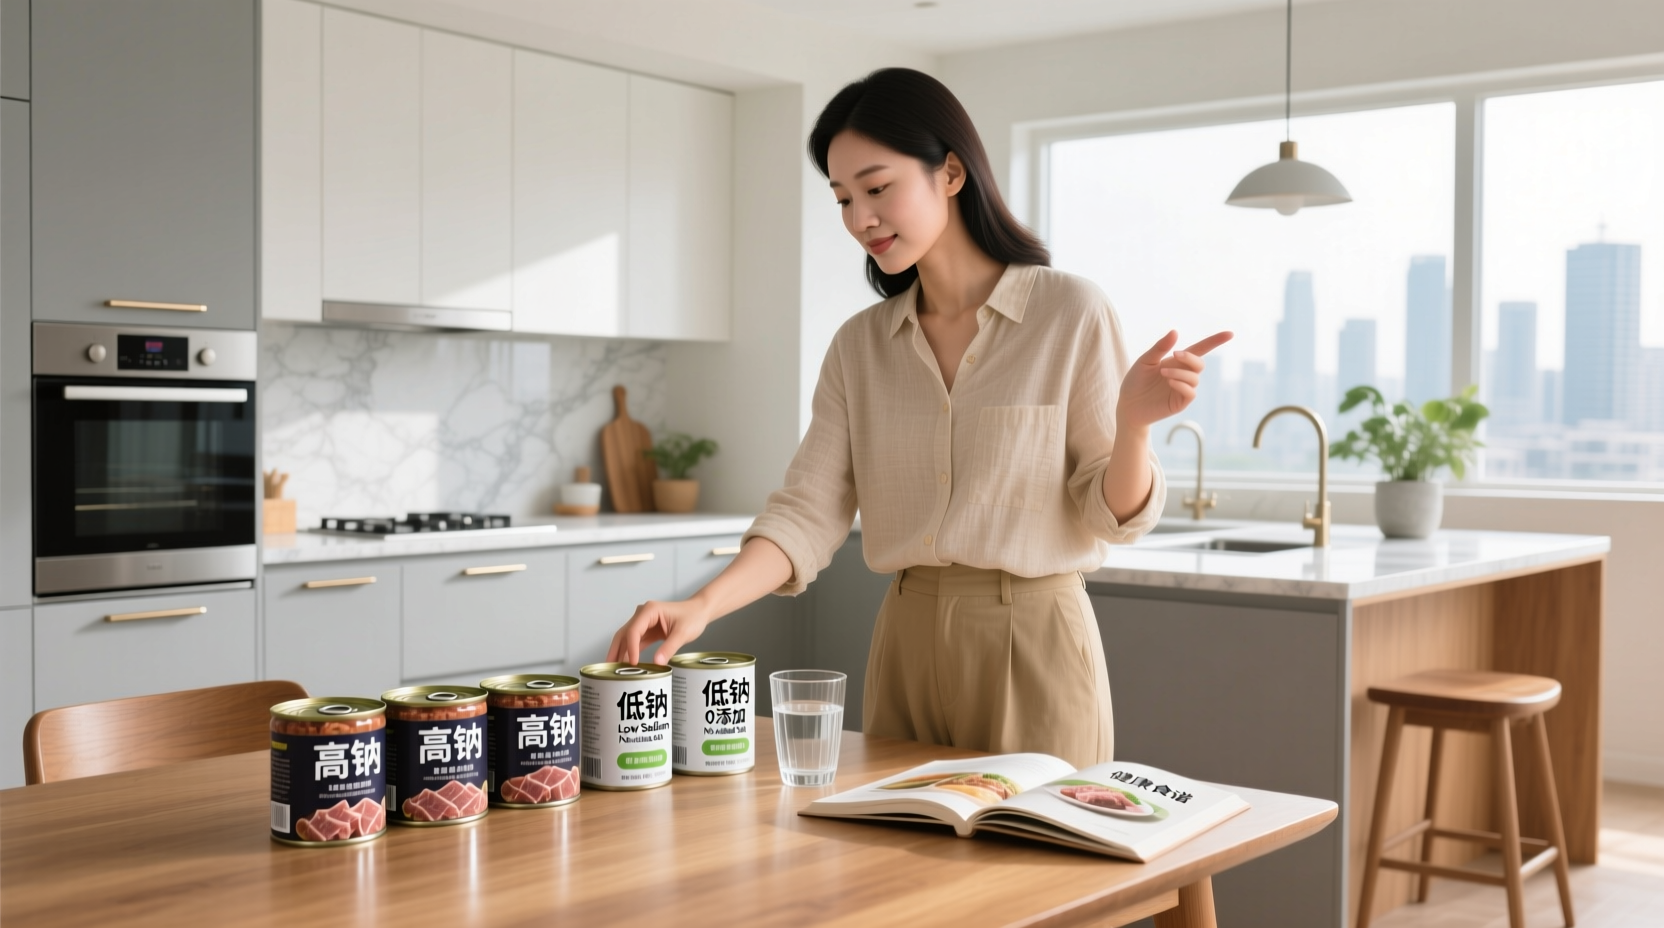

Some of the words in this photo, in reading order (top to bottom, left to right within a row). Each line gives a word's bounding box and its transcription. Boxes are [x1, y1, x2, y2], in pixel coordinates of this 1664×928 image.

[616, 688, 668, 721] 低钠
[702, 677, 750, 707] 低钠
[418, 722, 482, 764] 高钠
[516, 710, 576, 749] 高钠
[618, 724, 639, 734] Low
[313, 736, 381, 781] 高钠
